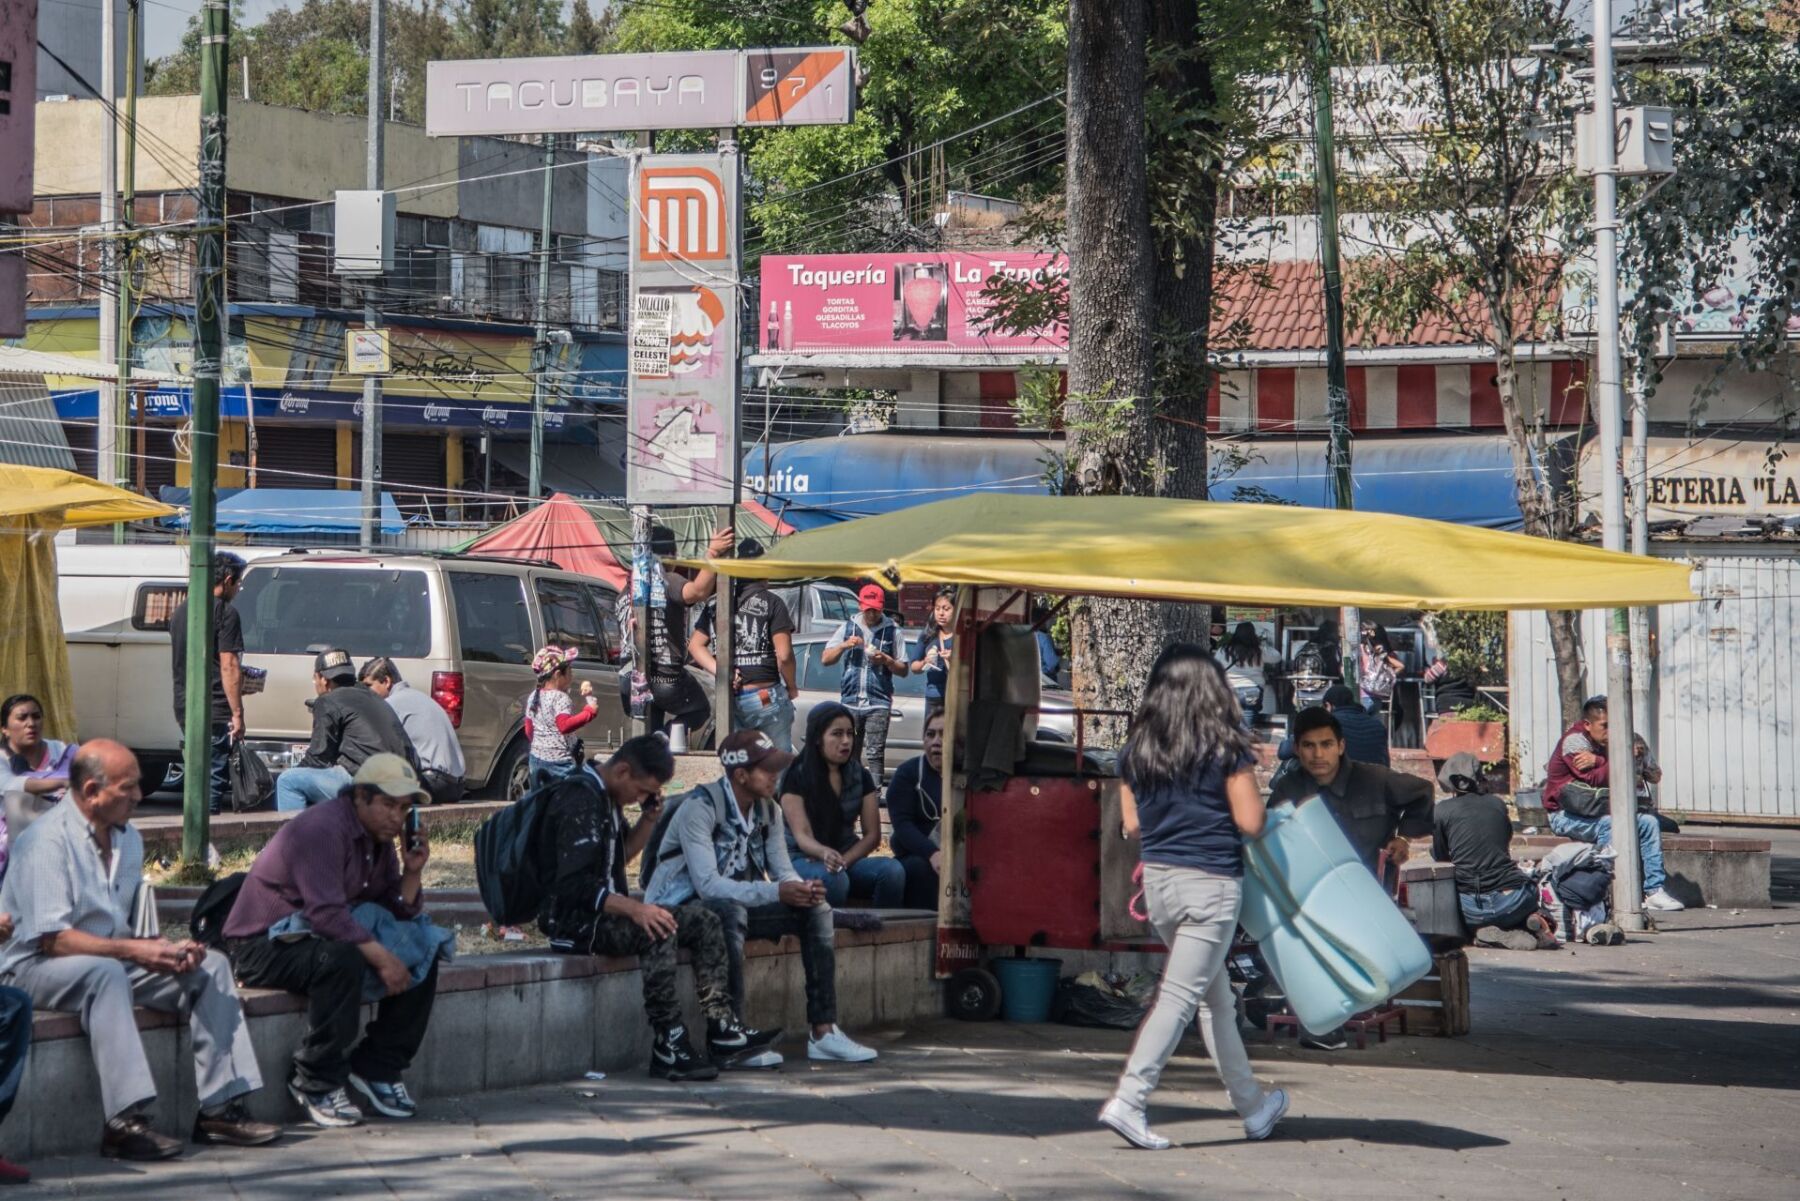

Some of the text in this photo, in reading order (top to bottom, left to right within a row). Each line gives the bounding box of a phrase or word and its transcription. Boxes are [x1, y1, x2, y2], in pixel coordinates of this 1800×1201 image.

[760, 68, 777, 89] 9
[787, 76, 807, 97] 7
[455, 73, 706, 113] TACUBAYA
[824, 84, 833, 105] 1
[787, 262, 886, 291] Taquería
[955, 261, 1069, 285] La Tapatí
[634, 351, 668, 359] CELESTE
[280, 392, 309, 411] Corona
[423, 402, 451, 420] Corona
[482, 404, 509, 422] Corona
[745, 465, 809, 492] apatía
